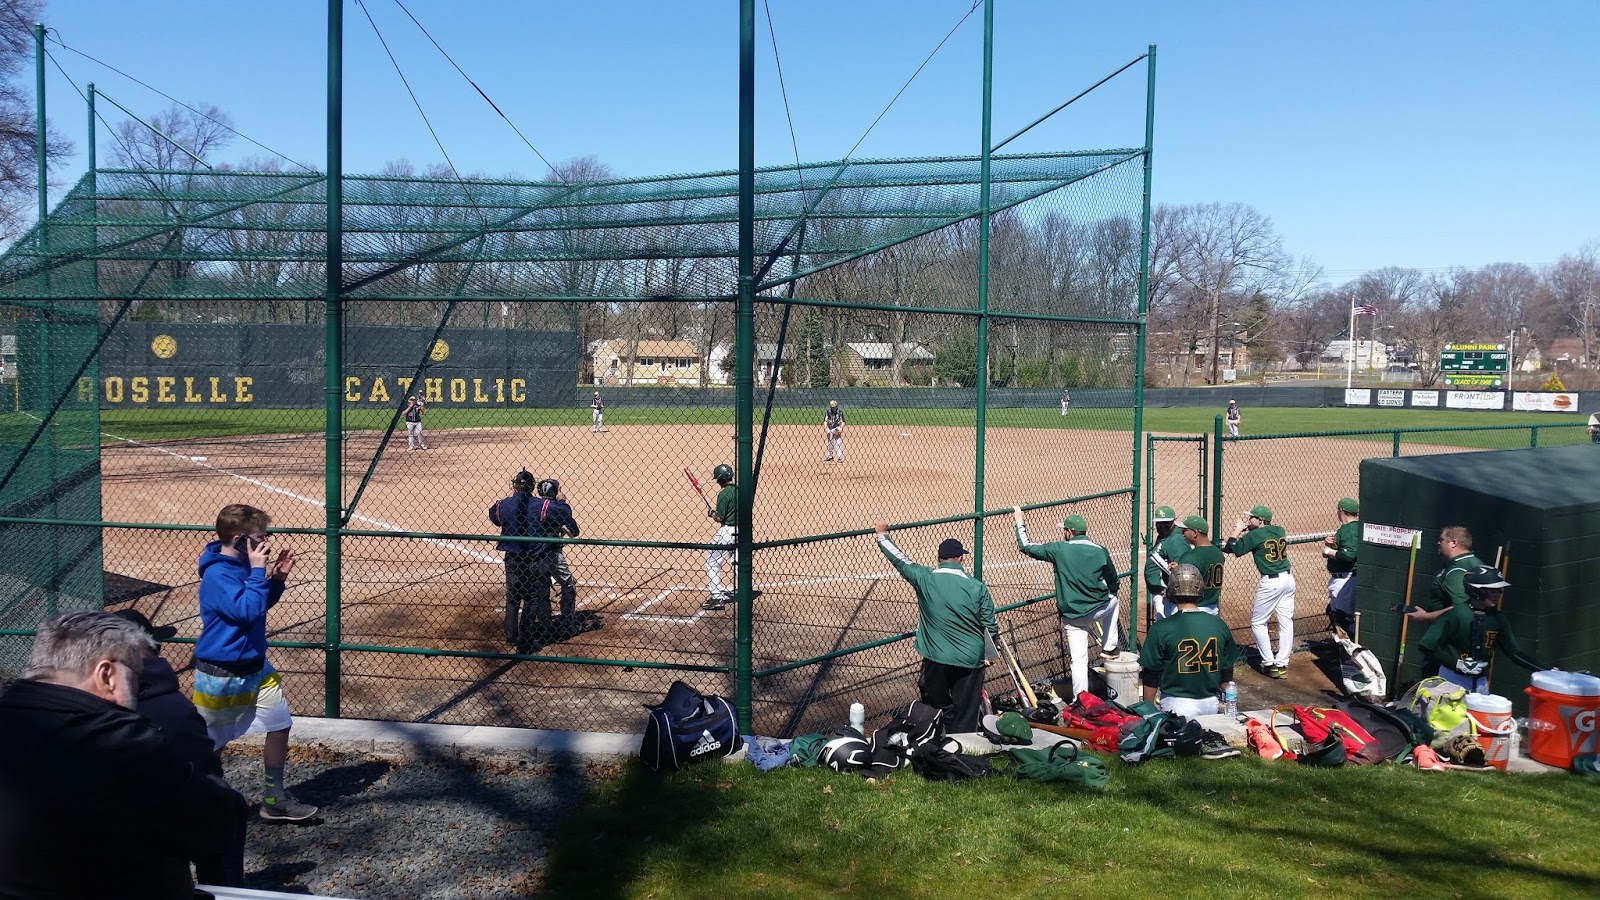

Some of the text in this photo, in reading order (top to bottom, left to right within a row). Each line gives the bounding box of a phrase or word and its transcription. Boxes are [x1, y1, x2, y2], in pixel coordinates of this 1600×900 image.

[77, 376, 526, 403] ROSELLE CATHOLIC
[1264, 537, 1287, 562] 32
[1377, 538, 1398, 546] PERMIT
[1204, 563, 1223, 589] 10
[1177, 637, 1219, 674] 24
[1575, 710, 1595, 732] G
[690, 740, 721, 757] adidas
